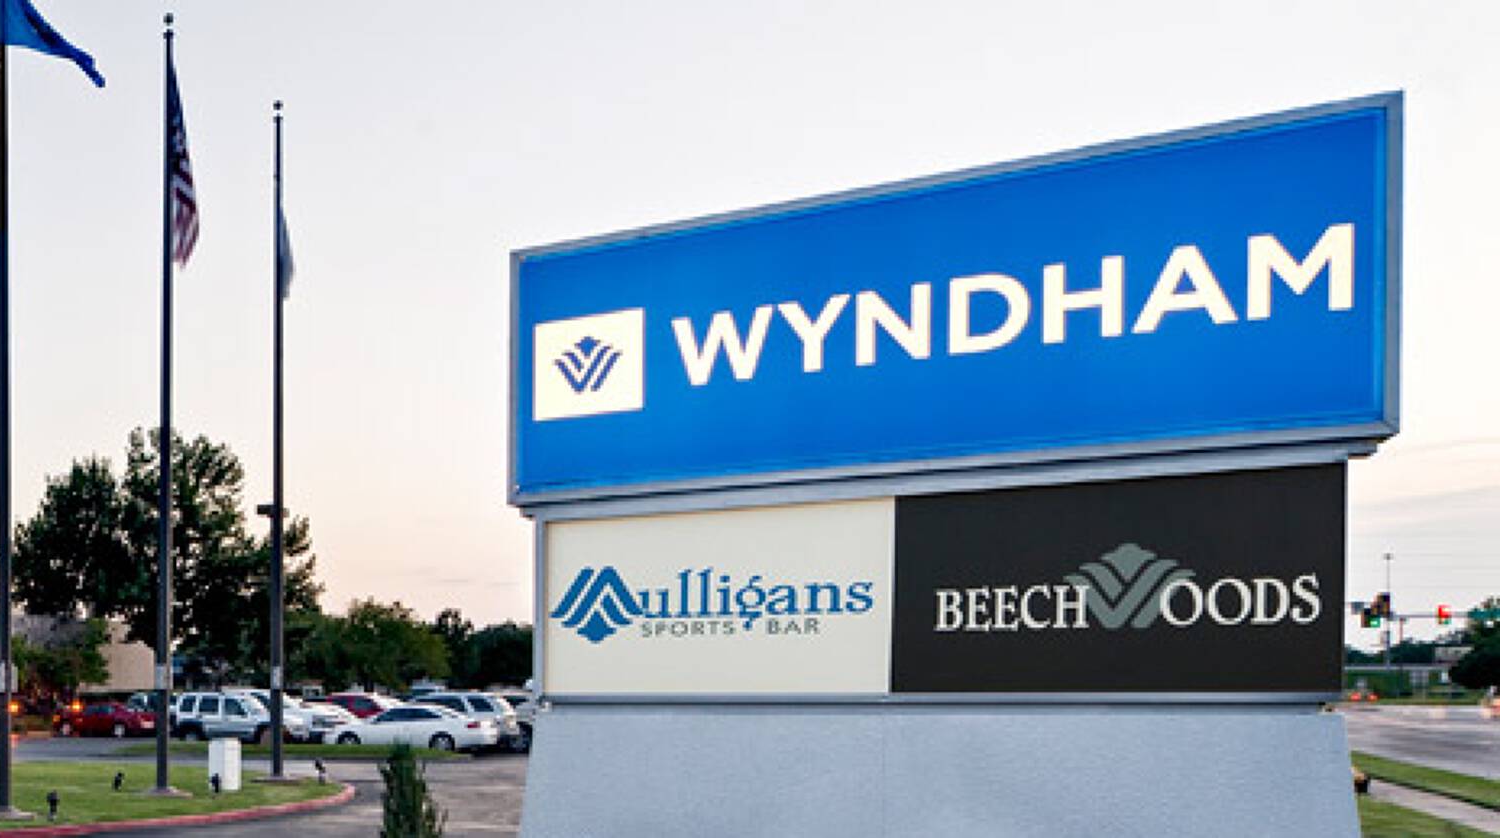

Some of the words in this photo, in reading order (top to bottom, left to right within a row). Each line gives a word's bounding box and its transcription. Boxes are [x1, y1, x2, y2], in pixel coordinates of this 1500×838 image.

[671, 222, 1355, 386] WYNDHAM
[550, 565, 874, 644] Mulligans
[640, 620, 736, 638] SPORTS
[766, 617, 821, 636] BAR
